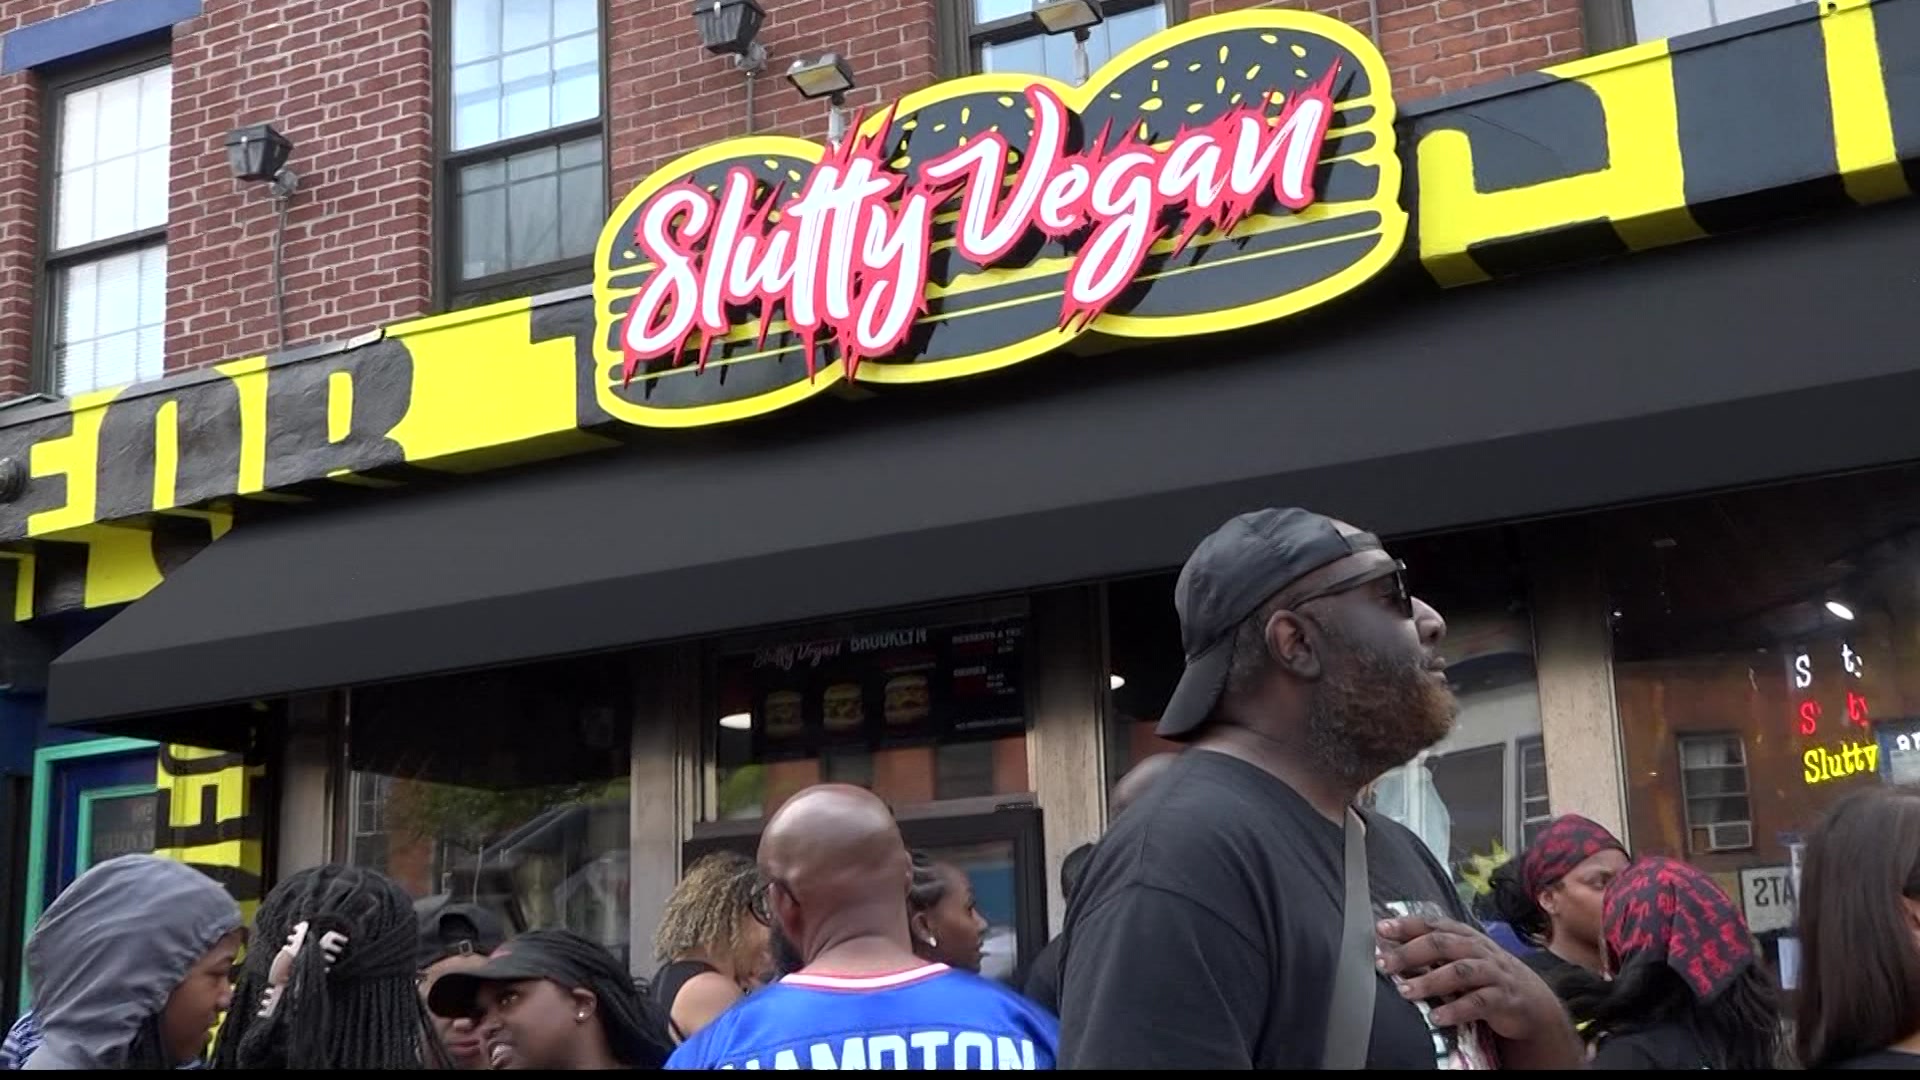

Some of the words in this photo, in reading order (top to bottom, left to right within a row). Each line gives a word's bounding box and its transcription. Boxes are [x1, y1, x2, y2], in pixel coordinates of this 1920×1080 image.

[622, 152, 930, 352] Slutty
[926, 84, 1334, 308] Vegan
[1803, 742, 1879, 784] Slutty
